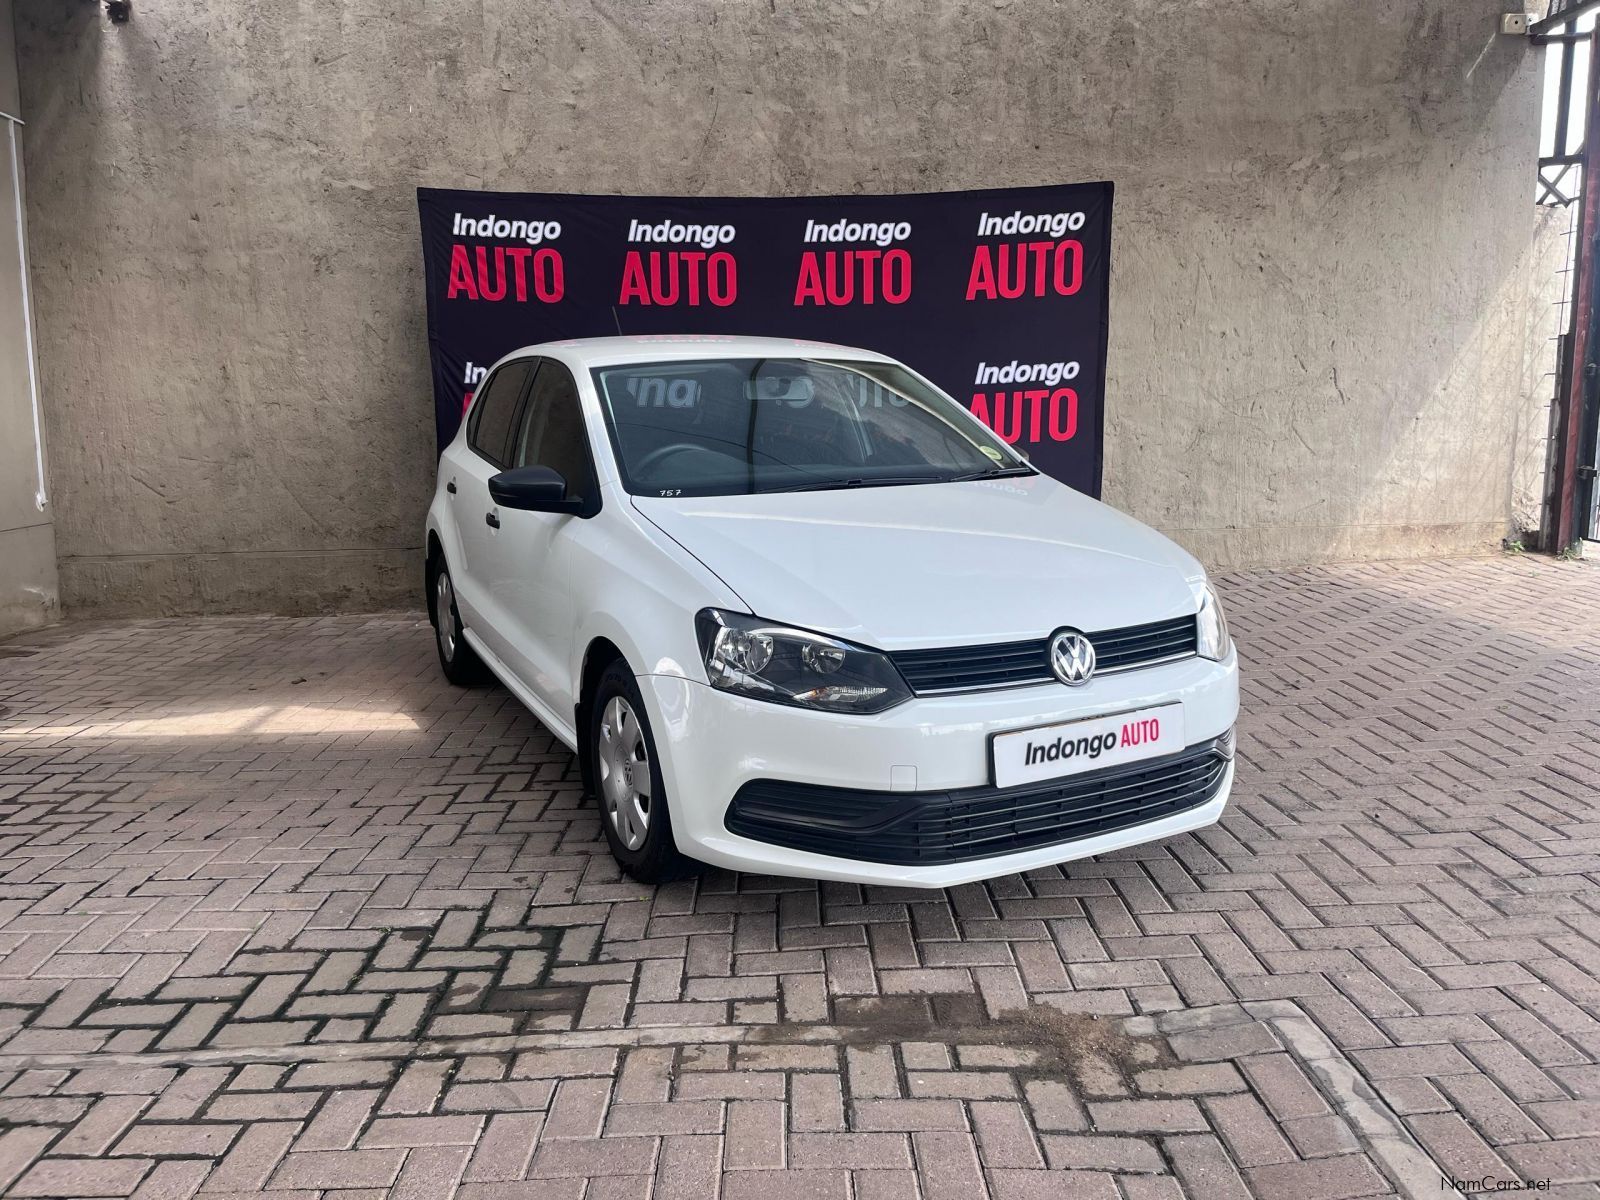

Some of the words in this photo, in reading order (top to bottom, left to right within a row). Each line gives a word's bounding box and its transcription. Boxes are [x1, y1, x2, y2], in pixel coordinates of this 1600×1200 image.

[453, 212, 562, 246] Indongo
[627, 219, 736, 249] Indongo
[804, 218, 912, 247] Indongo
[977, 210, 1086, 238] Indongo
[447, 244, 565, 304] AUTO
[619, 250, 738, 307] AUTO
[793, 249, 912, 306] AUTO
[965, 239, 1084, 301] AUTO
[974, 360, 1081, 387] Indongo
[969, 387, 1079, 445] AUTO
[1024, 731, 1117, 766] Indongo
[1120, 718, 1160, 748] AUTO
